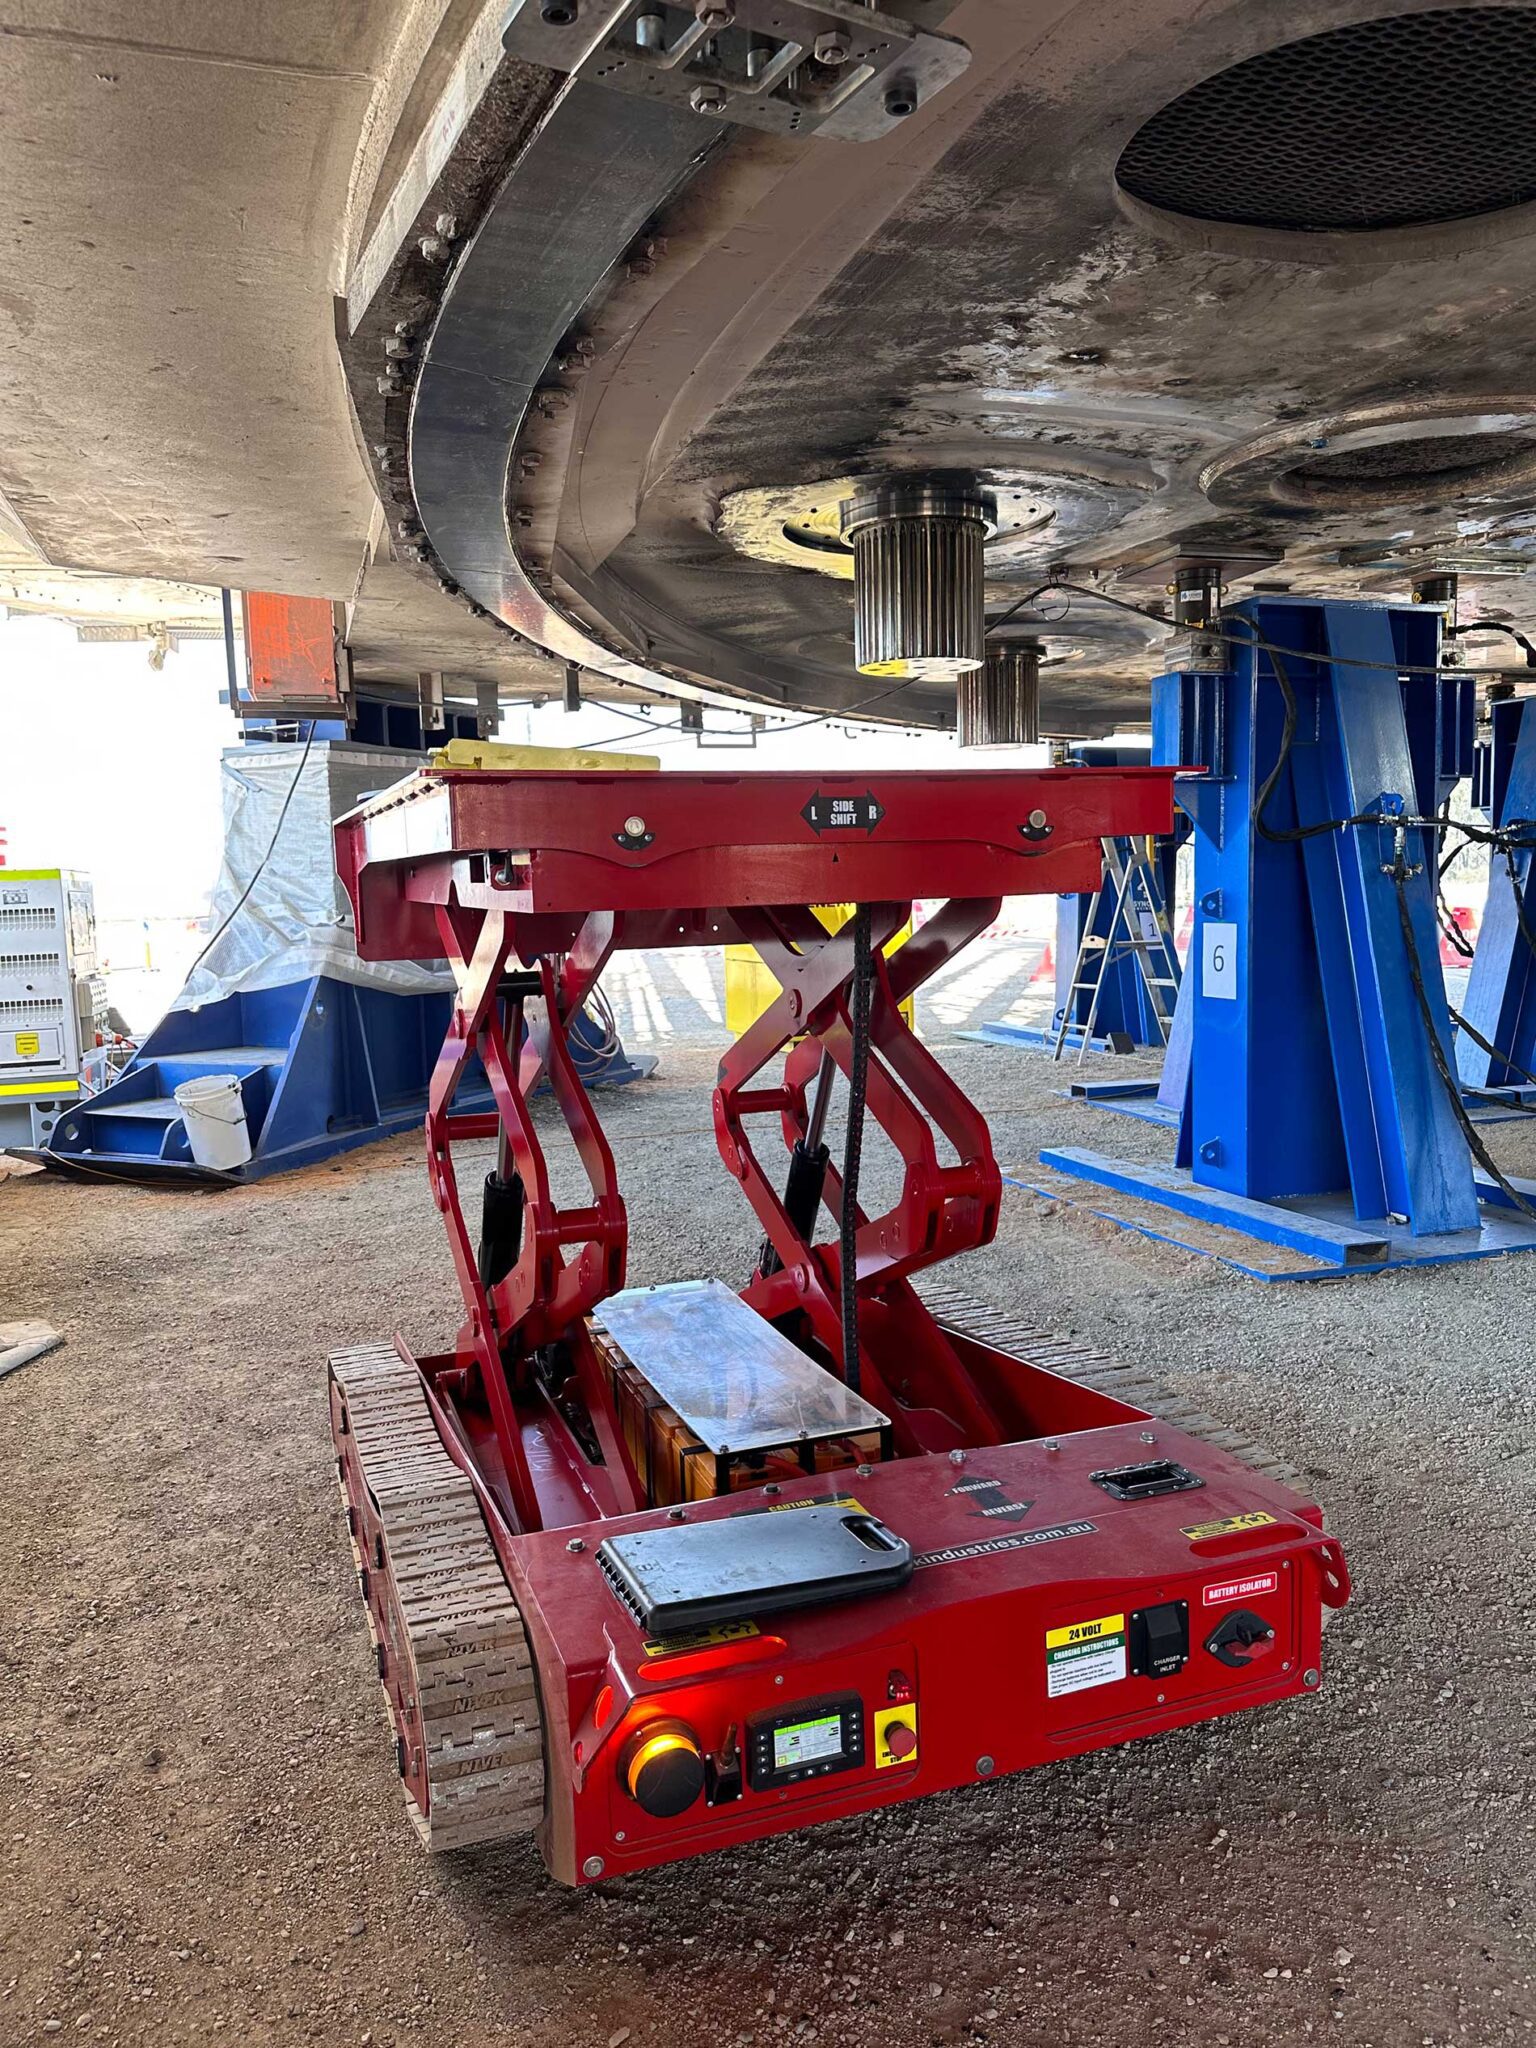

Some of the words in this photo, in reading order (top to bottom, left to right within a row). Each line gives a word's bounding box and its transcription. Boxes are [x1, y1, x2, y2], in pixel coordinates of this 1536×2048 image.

[811, 806, 818, 820] L
[832, 800, 854, 812] SIDE
[868, 805, 877, 819] R
[830, 813, 857, 825] SHIFT
[1148, 922, 1157, 937] 1
[1213, 944, 1225, 972] 6
[951, 1479, 1001, 1494] FORWARD
[768, 1499, 815, 1512] CAUTION
[981, 1502, 1027, 1517] REVERSE
[1208, 1584, 1239, 1600] BATTERY
[1239, 1577, 1272, 1593] ISOLATOR
[1069, 1629, 1081, 1641] 24
[1081, 1623, 1102, 1637] VOLT
[447, 1637, 497, 1659] NIVEK
[1053, 1647, 1081, 1661] CHARGING
[1081, 1637, 1119, 1654] INSTRUCTIONS
[1153, 1655, 1181, 1667] CHARGER
[1159, 1663, 1176, 1673] INLET
[453, 1690, 505, 1714] NIVEK
